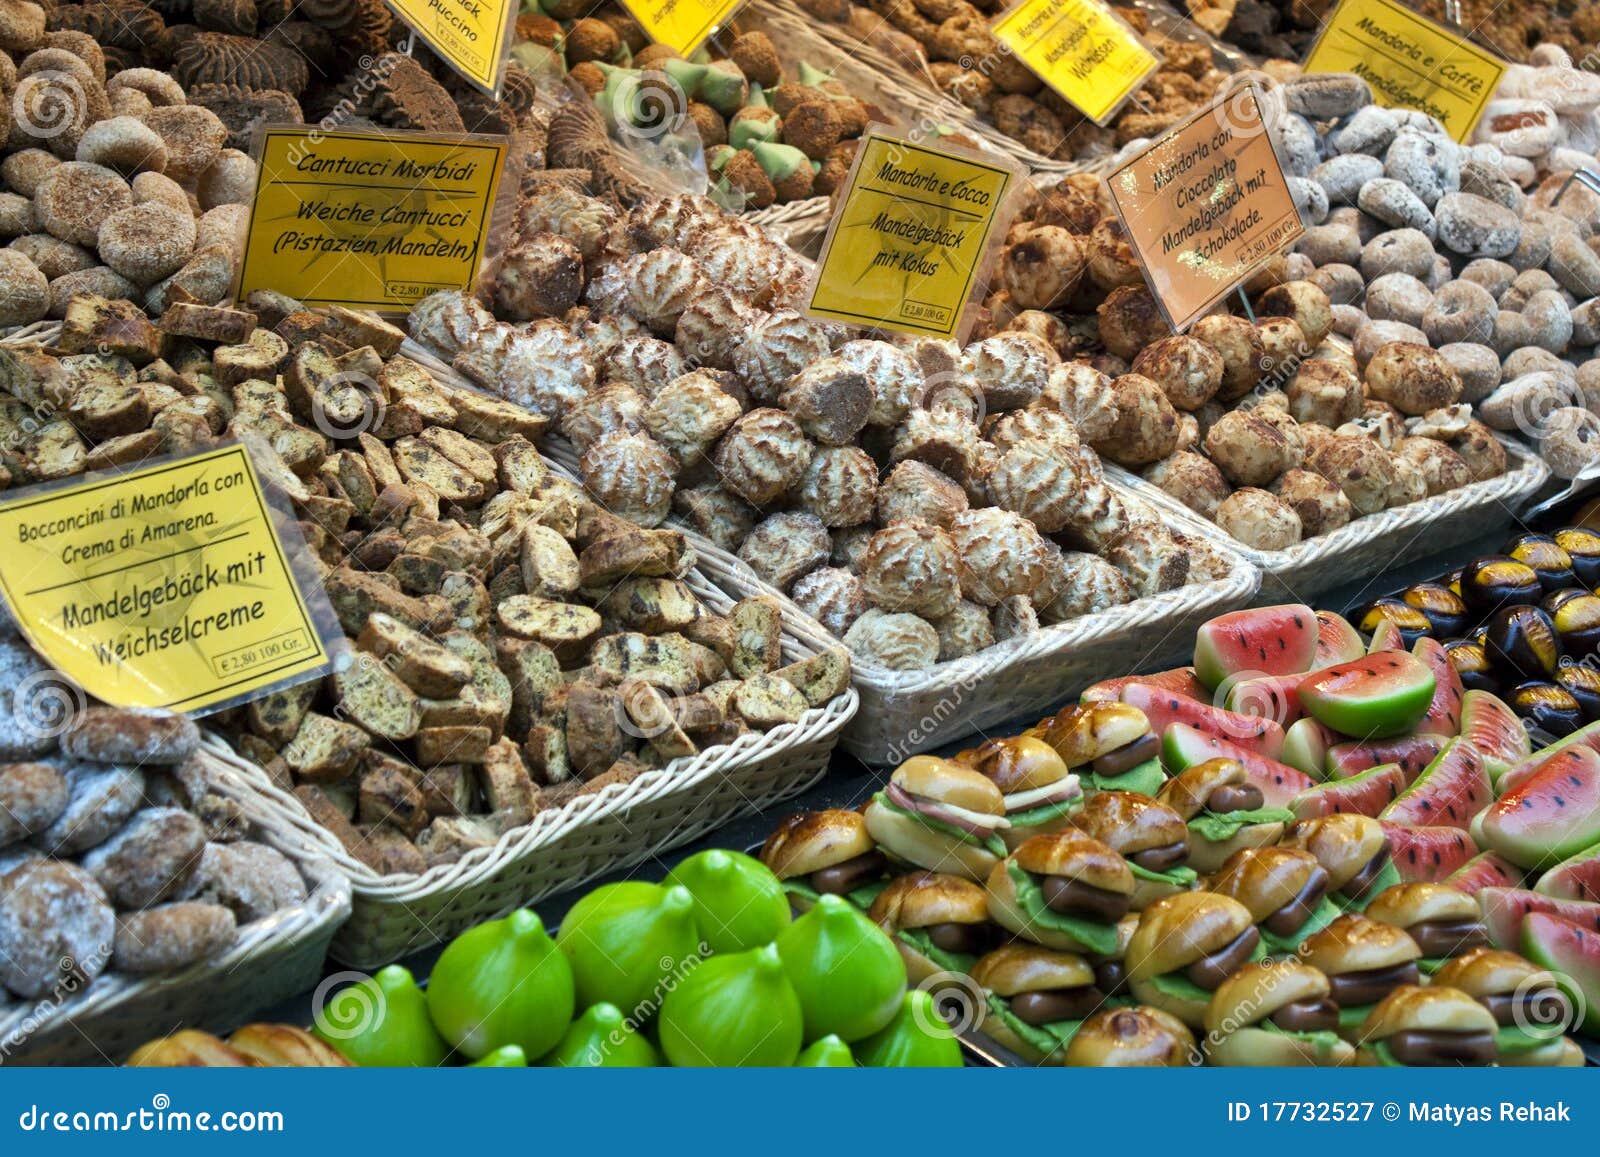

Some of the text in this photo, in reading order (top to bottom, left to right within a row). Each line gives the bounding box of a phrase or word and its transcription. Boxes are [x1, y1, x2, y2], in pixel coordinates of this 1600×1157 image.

[428, 0, 478, 41] puccino
[1355, 17, 1423, 62] Mandorla
[1423, 56, 1435, 67] e
[1350, 62, 1451, 123] Mandelgebäck
[296, 153, 478, 181] Cantucci Morbidi
[877, 161, 990, 207] Mandorla e Cocco.
[1152, 126, 1234, 193] Mandorla con
[1175, 158, 1238, 209] Cioccolato
[296, 200, 471, 228] Weiche Cantucci
[870, 212, 965, 249] Mandelgebäck
[1161, 167, 1268, 255] Mandelgebäck mit
[1195, 207, 1264, 264] Schokolade.
[872, 249, 940, 277] mit Kokus
[18, 470, 245, 543] Bocconcini di Mandorla con
[61, 510, 218, 565] Crema di Amarena.
[62, 550, 267, 631] Mandelgebäck mit
[92, 599, 266, 667] Weichselcreme
[231, 650, 257, 669] 2,80
[259, 642, 281, 660] 100
[282, 638, 302, 651] Gr.
